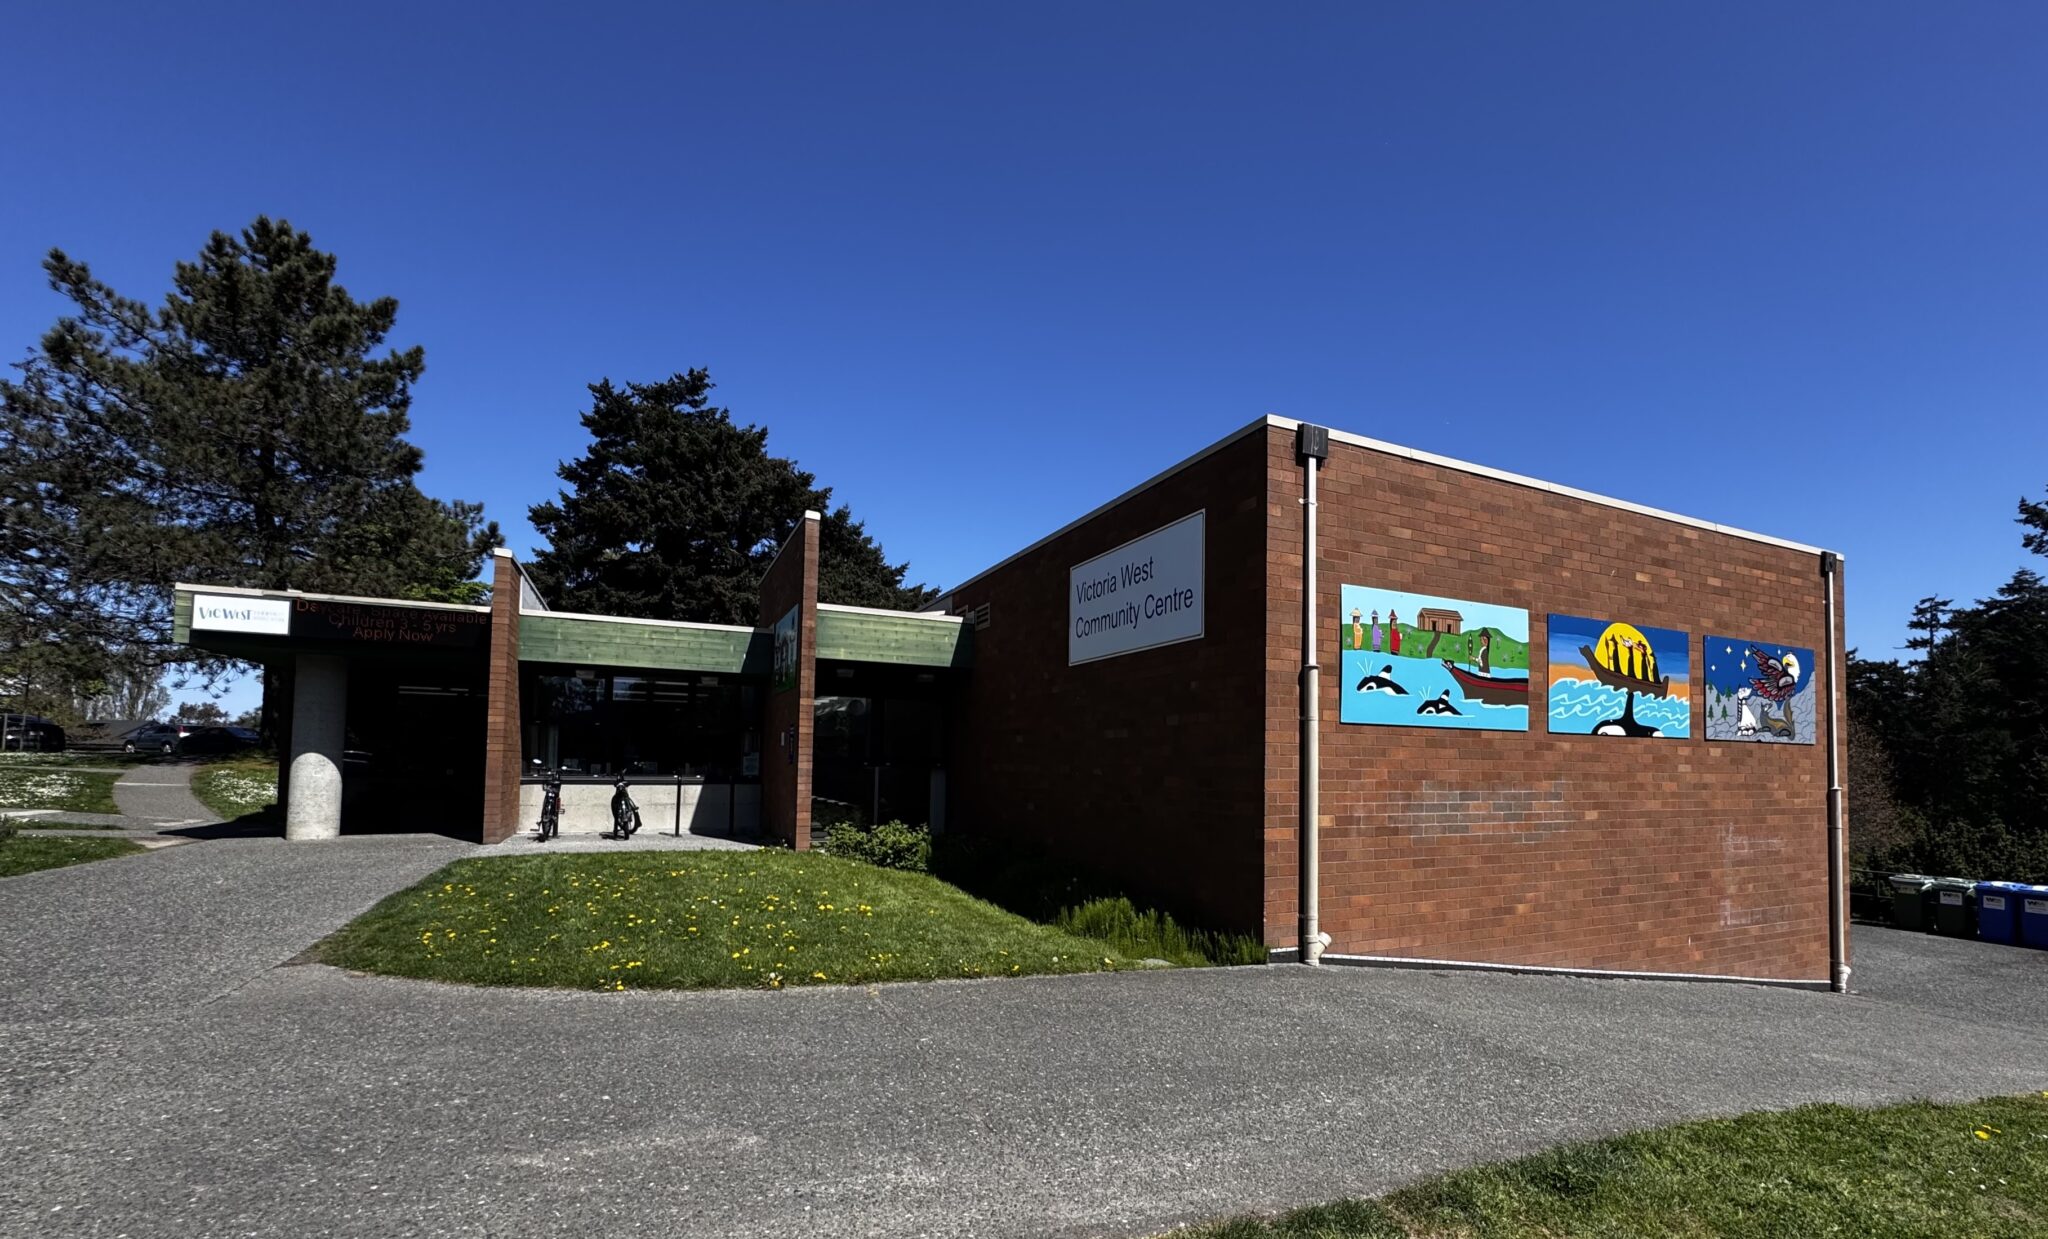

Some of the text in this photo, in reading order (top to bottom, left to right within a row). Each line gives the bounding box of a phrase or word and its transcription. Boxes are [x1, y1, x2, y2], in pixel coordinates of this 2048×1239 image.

[1076, 556, 1154, 605] Victoria West
[328, 613, 395, 629] Children
[400, 618, 409, 631] 3
[423, 620, 432, 632] 5
[434, 621, 457, 633] yrs
[422, 609, 488, 625] Available
[1075, 587, 1194, 639] Community Centre
[353, 626, 434, 642] Apply Now
